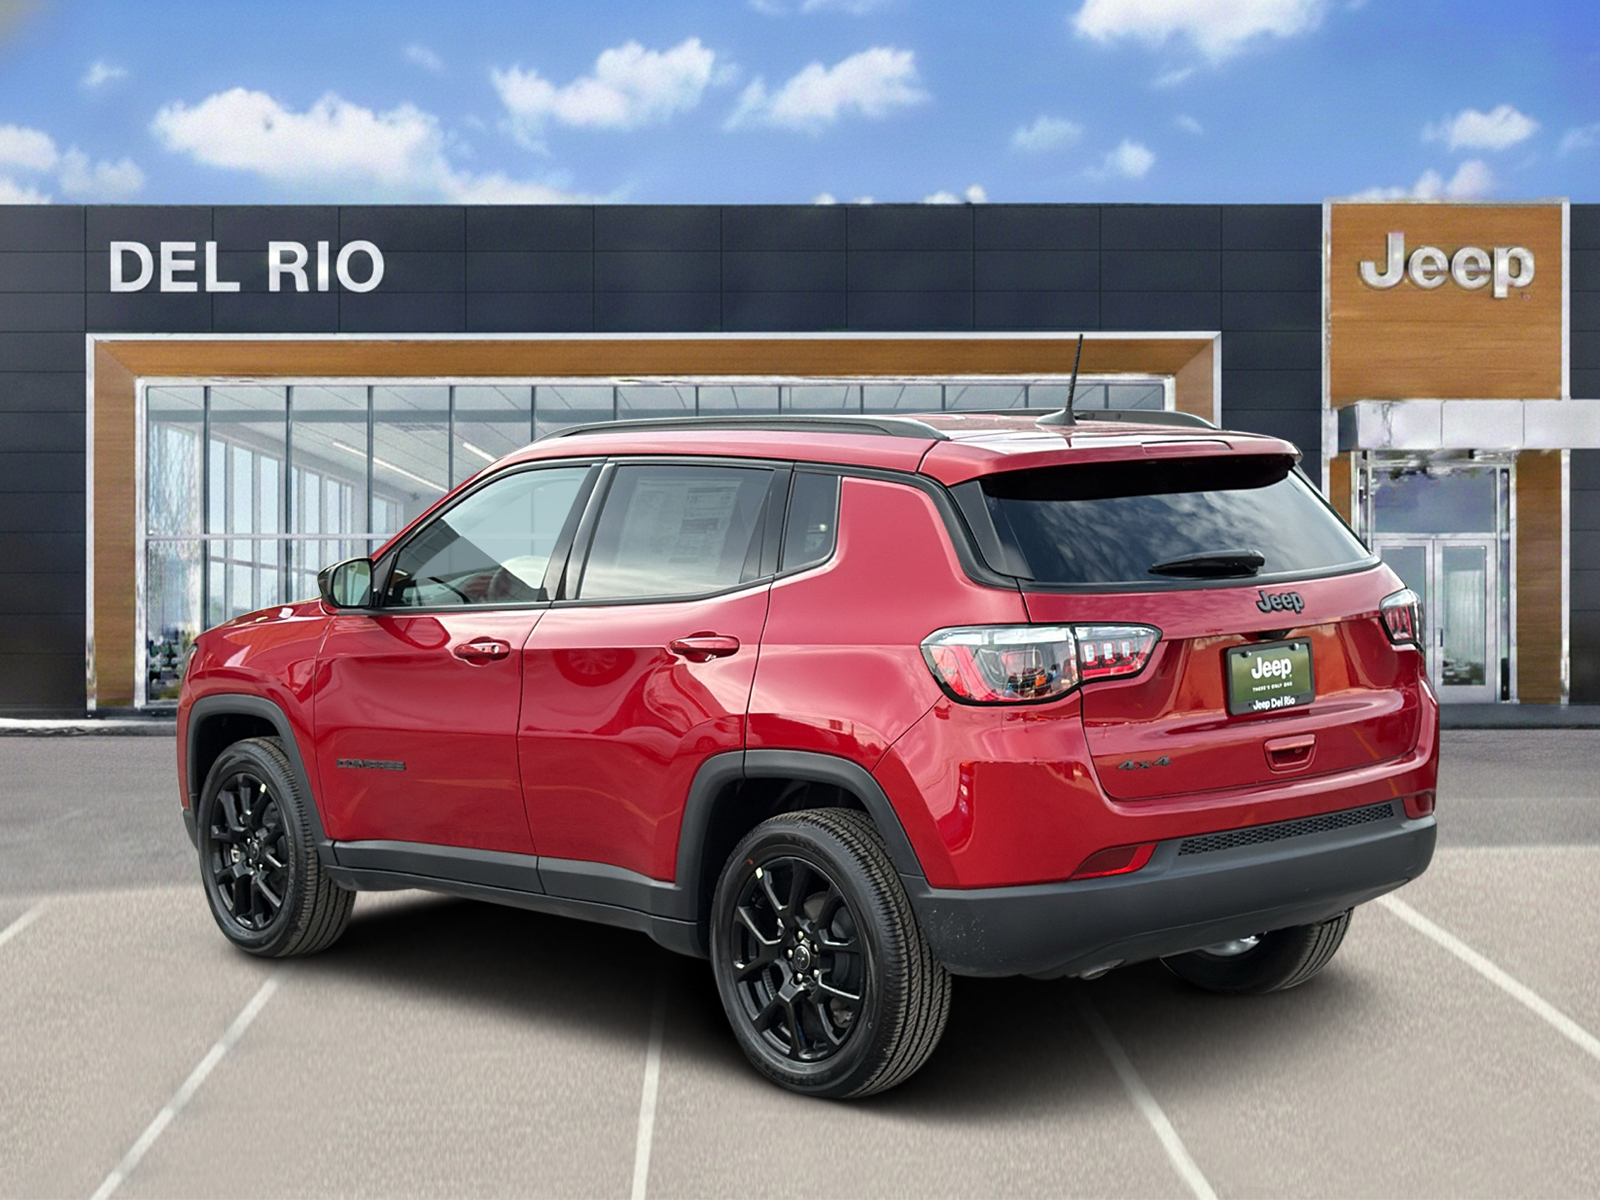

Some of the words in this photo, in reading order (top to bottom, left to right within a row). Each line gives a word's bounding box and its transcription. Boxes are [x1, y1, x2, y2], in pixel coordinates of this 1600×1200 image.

[110, 240, 241, 293] DEL
[268, 239, 385, 293] RIO
[1359, 231, 1536, 299] Jeep
[1256, 590, 1305, 614] Jeep
[1251, 657, 1292, 679] Jeep
[1253, 699, 1270, 710] Jeep
[1270, 696, 1283, 708] Del
[1284, 695, 1296, 706] Rio
